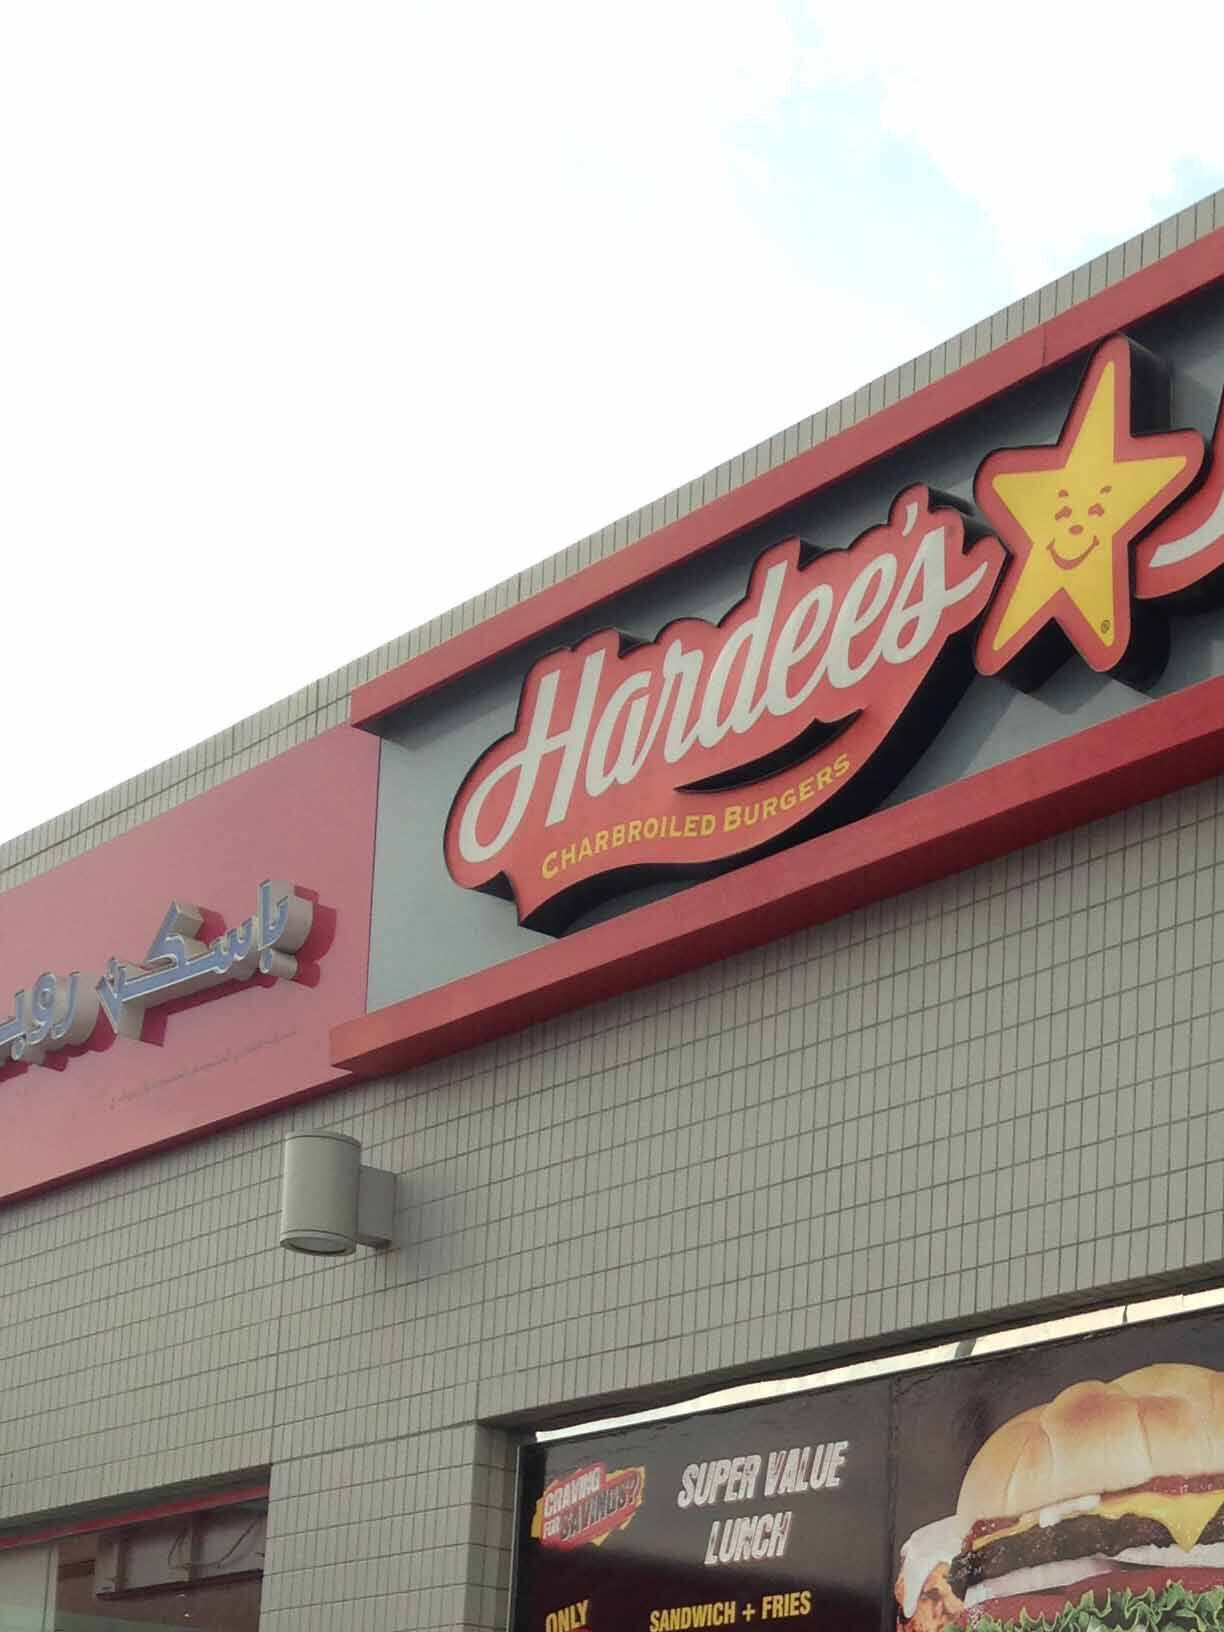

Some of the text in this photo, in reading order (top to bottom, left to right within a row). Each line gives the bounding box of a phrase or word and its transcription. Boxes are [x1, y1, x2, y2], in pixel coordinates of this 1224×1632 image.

[458, 502, 988, 863] Hardee's
[540, 753, 852, 880] CHARBROILED BURGERS
[99, 878, 290, 1034] باسكن
[676, 1440, 850, 1509] SUPER VALUE
[702, 1511, 793, 1566] LUNCH
[742, 1606, 757, 1624] +
[761, 1590, 812, 1619] FRIES
